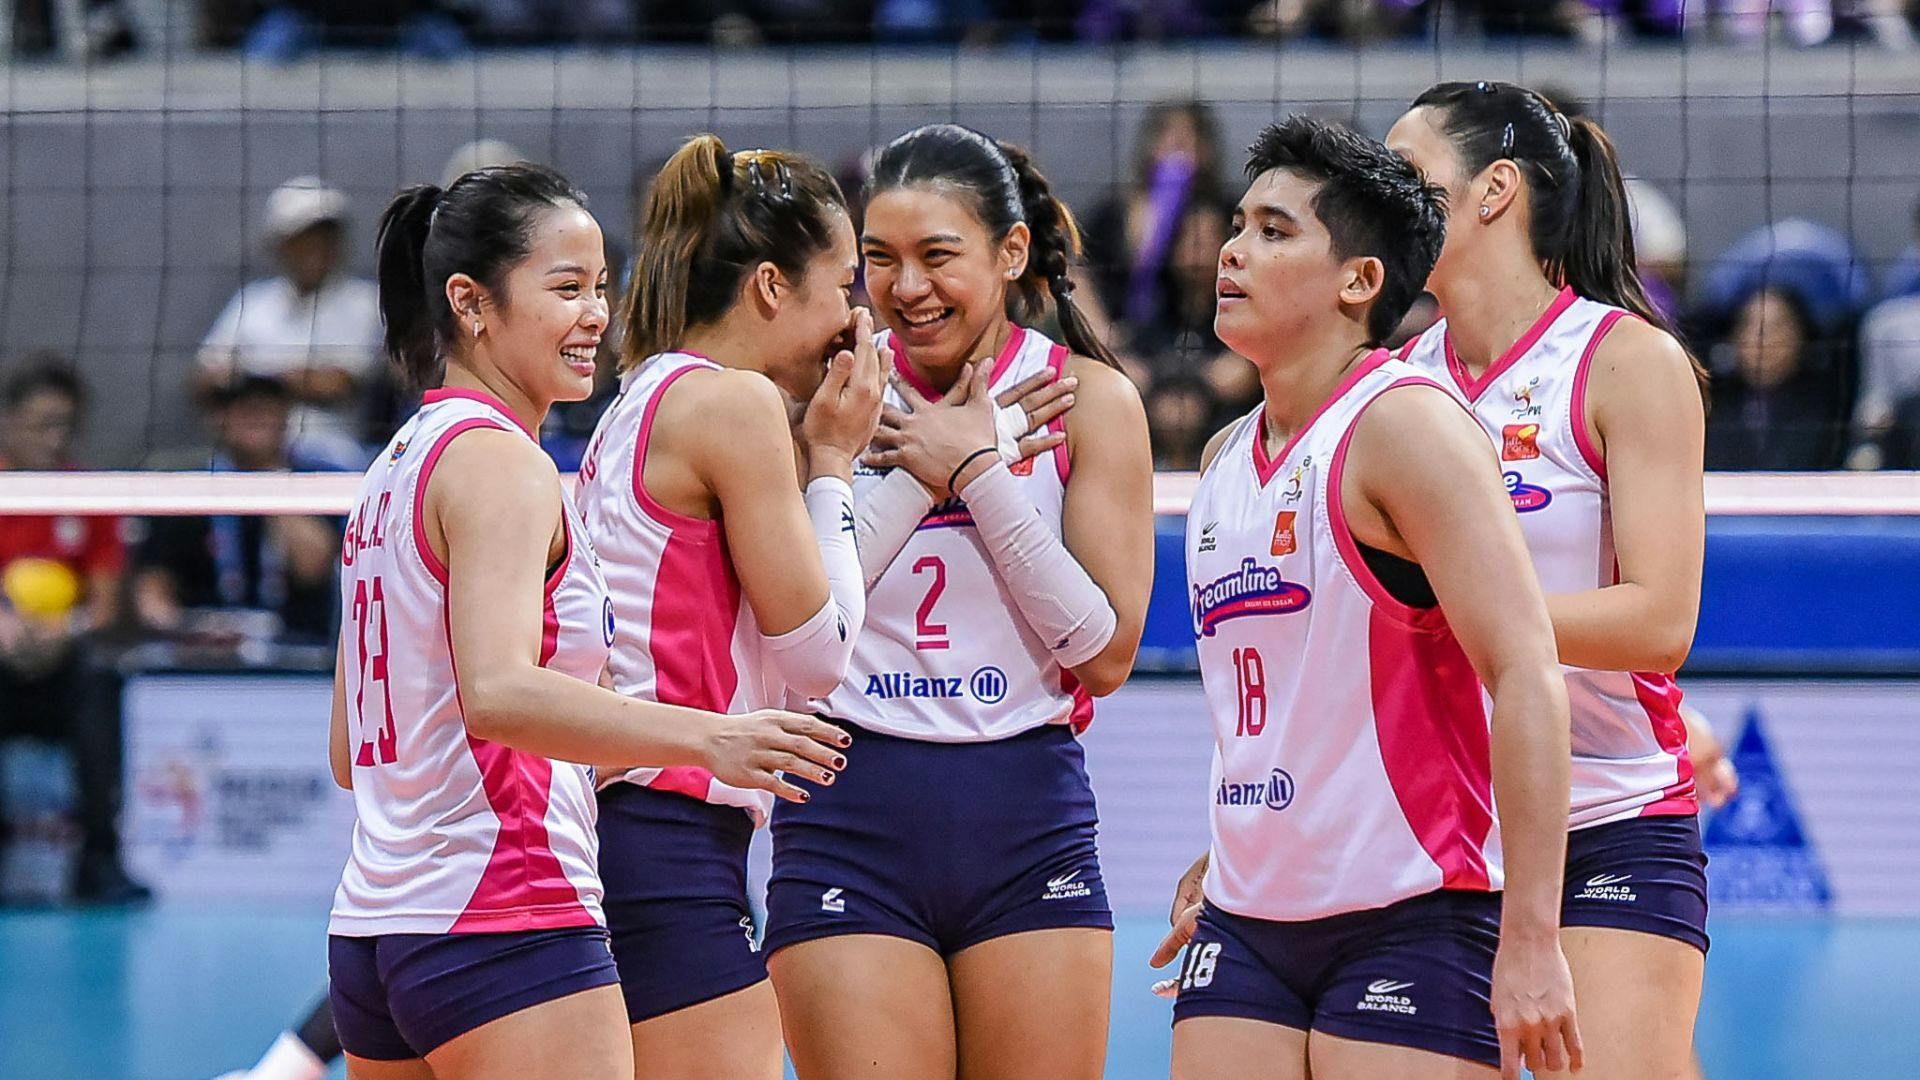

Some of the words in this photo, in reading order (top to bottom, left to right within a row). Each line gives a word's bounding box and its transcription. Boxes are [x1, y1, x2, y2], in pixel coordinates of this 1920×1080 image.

[912, 556, 947, 636] 2
[1193, 560, 1279, 637] Creamline
[352, 576, 397, 766] 23
[865, 673, 963, 699] Allianz
[1233, 648, 1267, 737] 18
[1049, 882, 1085, 893] WORLD
[1584, 886, 1630, 894] WORLD
[1356, 1001, 1418, 1015] BALANCE
[1364, 994, 1411, 1006] WORLD
